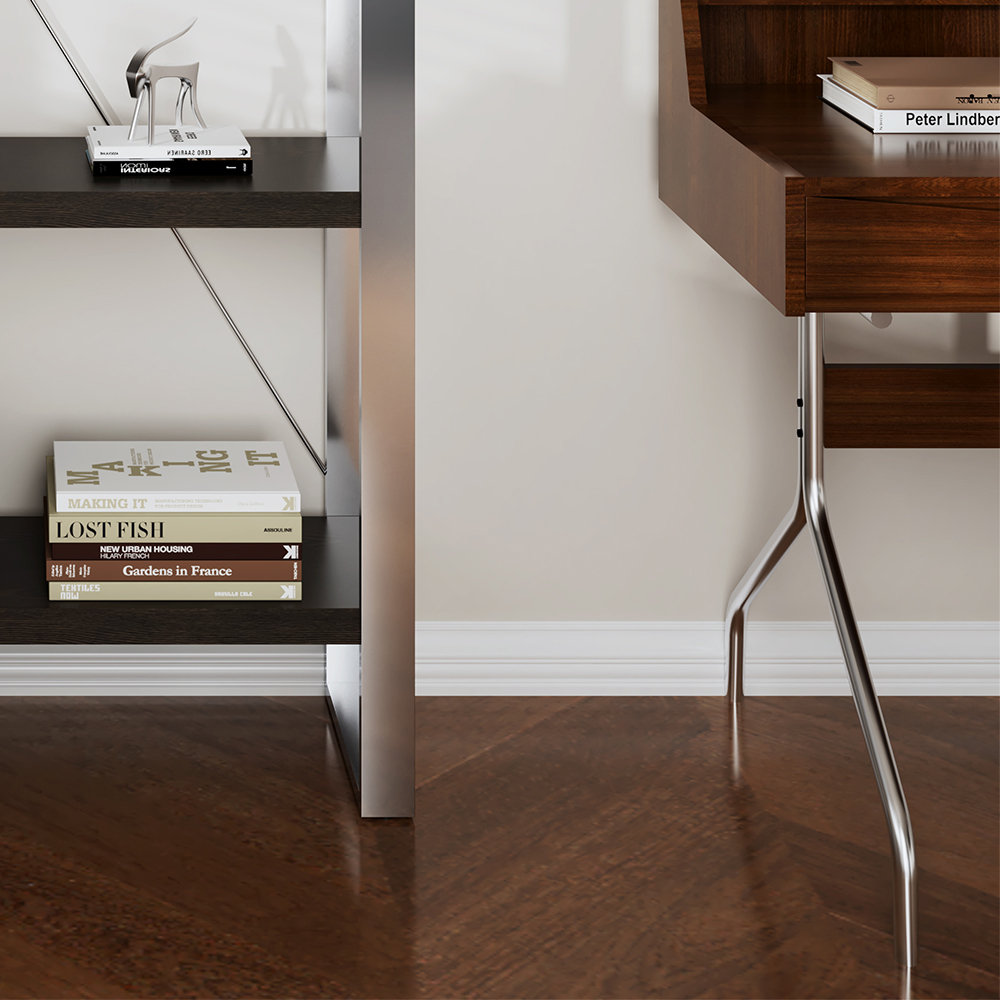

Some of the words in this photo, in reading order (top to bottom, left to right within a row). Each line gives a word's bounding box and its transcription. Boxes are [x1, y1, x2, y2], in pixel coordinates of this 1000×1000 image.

[906, 112, 942, 126] Peter
[946, 112, 1000, 126] Lindber
[68, 498, 129, 509] MAKING
[132, 498, 148, 509] IT
[56, 521, 111, 539] LOST
[117, 521, 165, 539] FISH
[100, 545, 119, 553] NEW
[122, 545, 151, 553] URBAN
[154, 545, 193, 553] HOUSING
[122, 565, 173, 576] Gardens
[176, 565, 188, 576] in
[192, 565, 233, 576] France
[60, 584, 101, 592] TEXTILES
